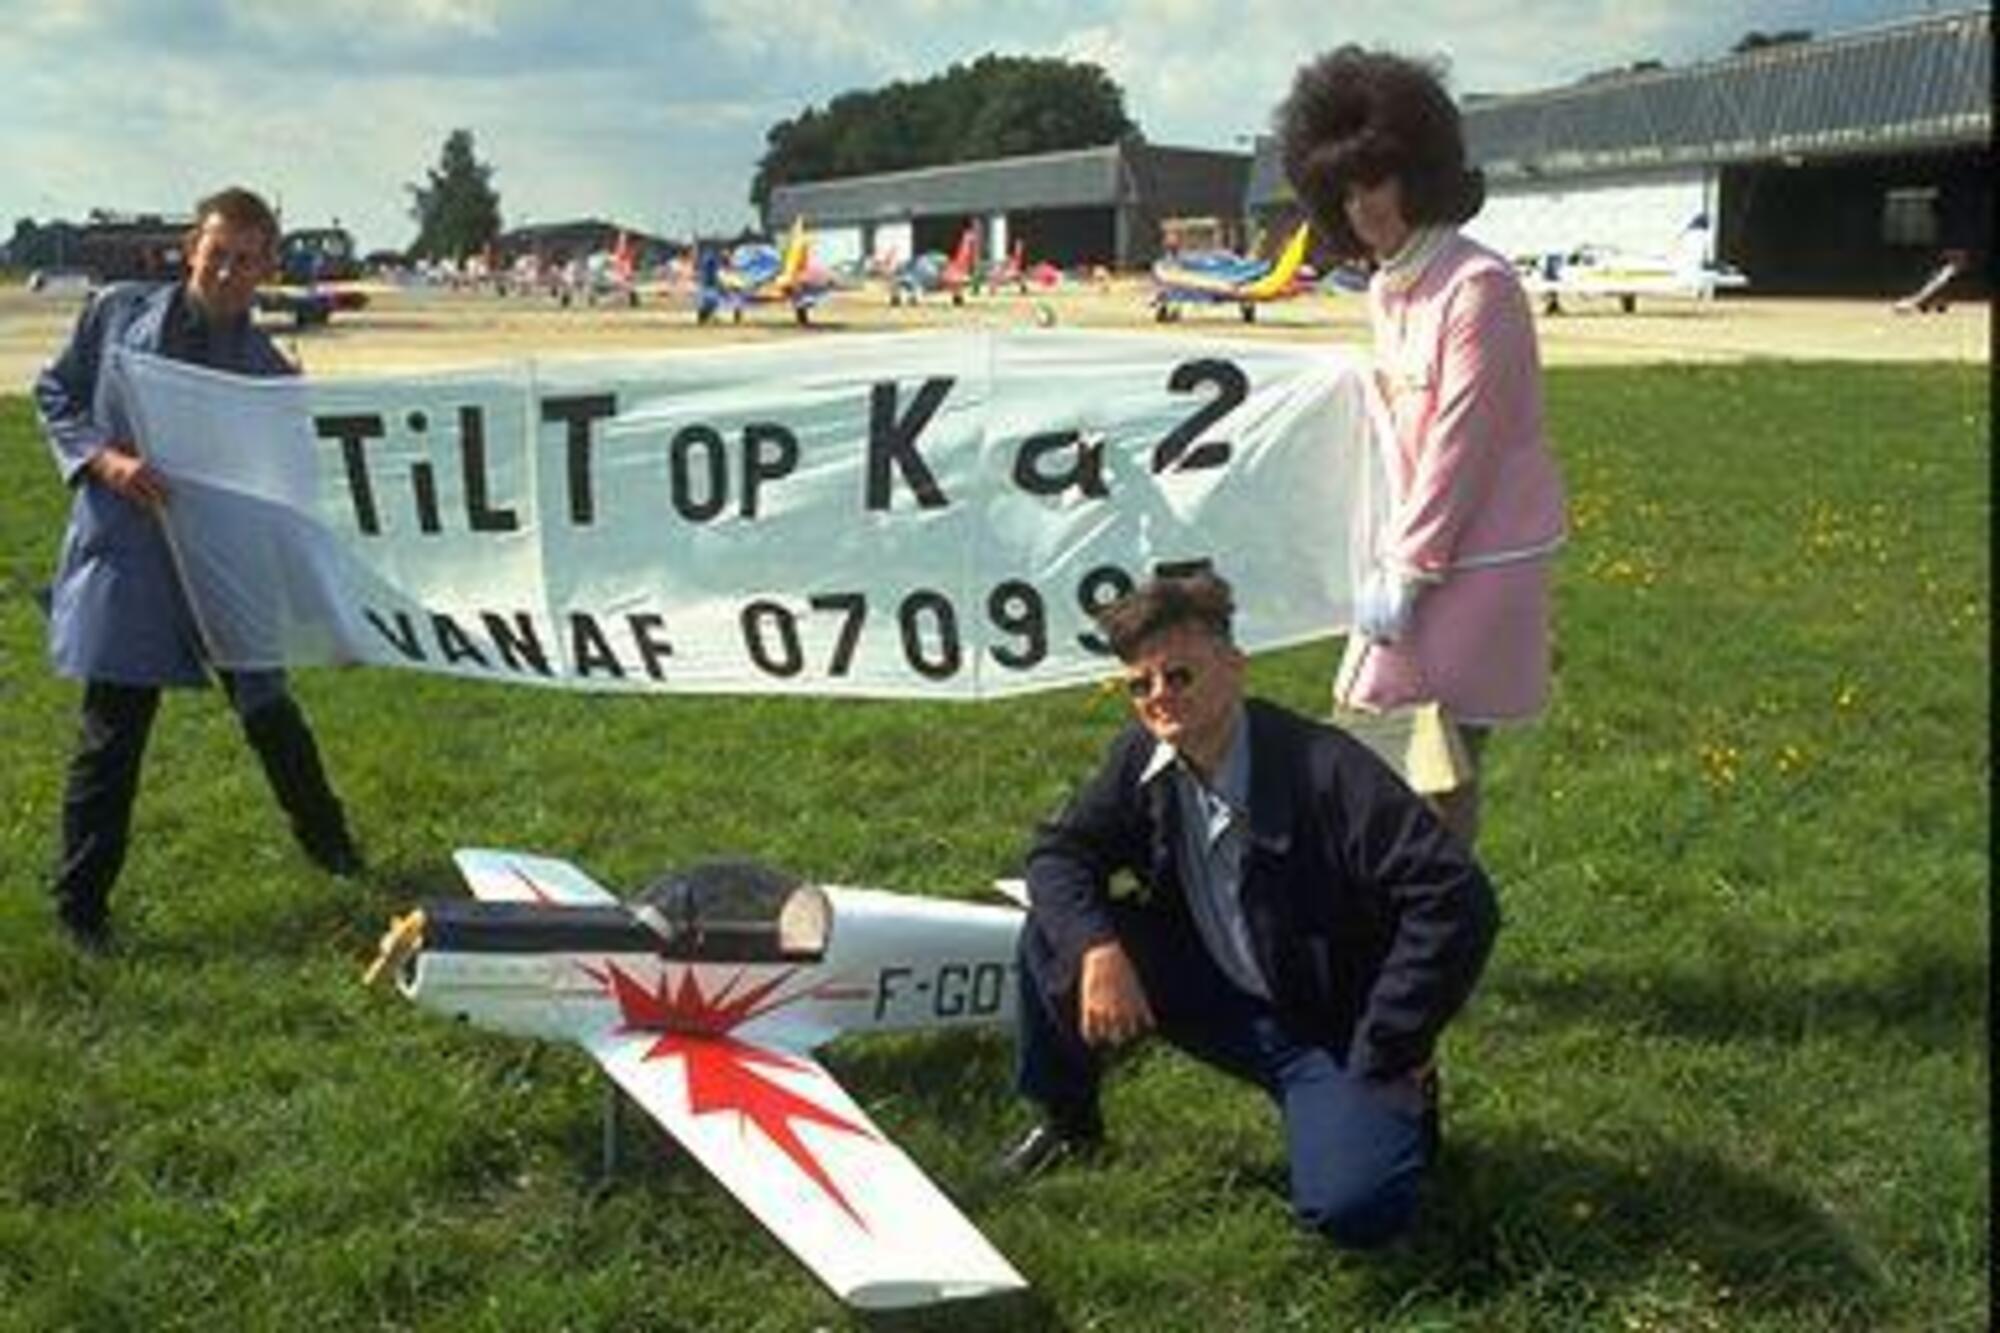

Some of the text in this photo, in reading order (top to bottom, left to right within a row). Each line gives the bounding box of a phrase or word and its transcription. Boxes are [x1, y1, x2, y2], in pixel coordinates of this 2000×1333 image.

[669, 422, 798, 523] OP
[364, 557, 1213, 681] VANAF 07099
[874, 962, 1019, 1022] F-GO
